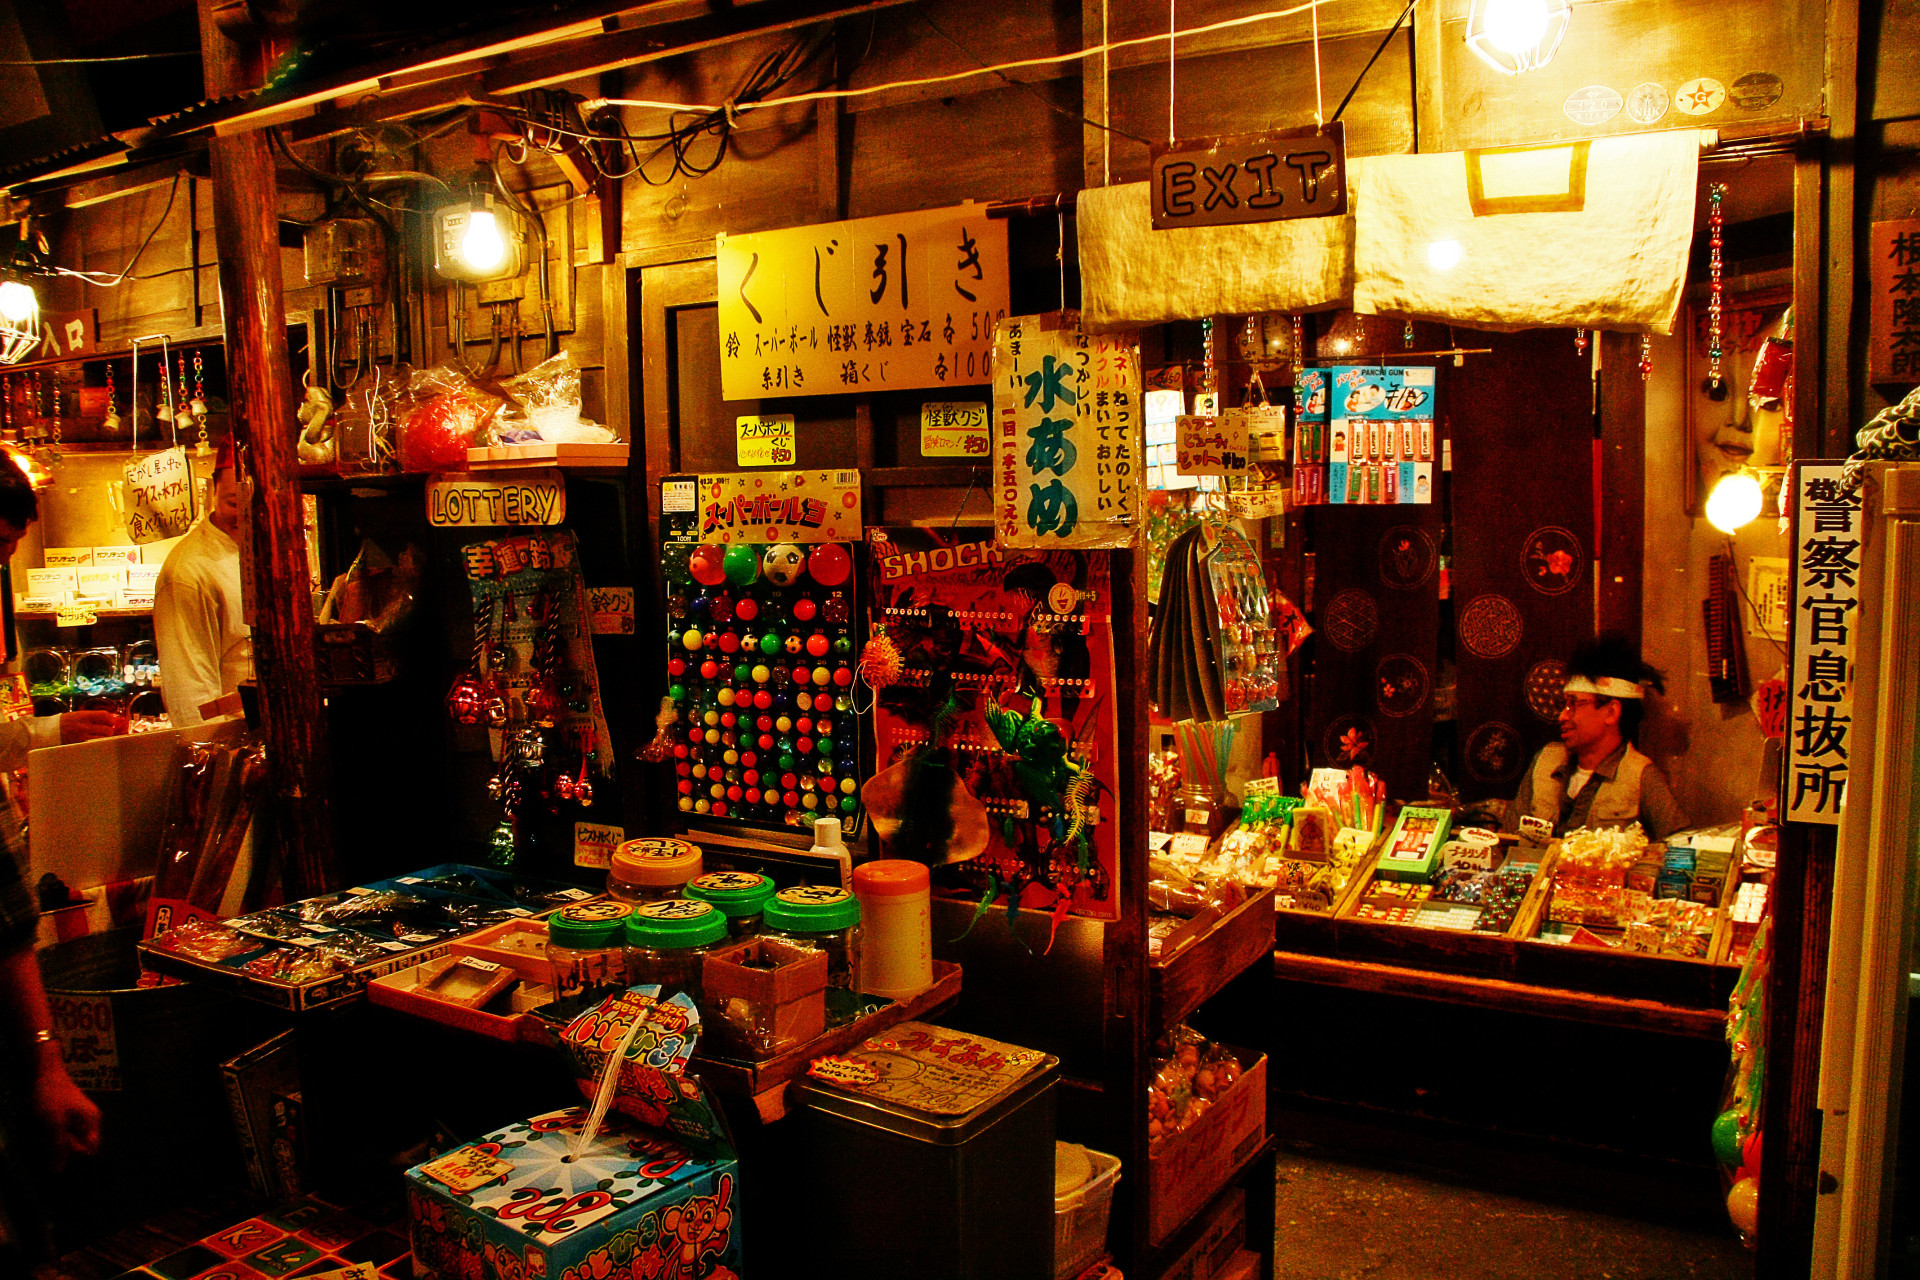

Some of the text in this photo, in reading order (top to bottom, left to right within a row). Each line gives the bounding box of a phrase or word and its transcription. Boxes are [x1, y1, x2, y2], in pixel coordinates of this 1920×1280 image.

[1694, 91, 1708, 104] G
[1162, 150, 1332, 217] EXIT
[740, 226, 983, 325] くじ引き
[41, 317, 84, 358] 入口
[726, 331, 741, 358] 鈴
[754, 325, 818, 357] スーパーボール
[827, 324, 858, 352] 怪獣
[900, 318, 931, 346] 宝石
[1008, 323, 1023, 390] あまーい
[761, 365, 805, 391] 糸引き
[924, 408, 985, 427] 怪獣クジ
[771, 437, 791, 447] くじ
[771, 446, 791, 463] ¥50
[964, 434, 988, 454] ¥50
[1023, 354, 1078, 539] 水あめ
[1178, 449, 1221, 470] セット
[432, 484, 557, 525] LOTTERY
[703, 494, 829, 535] スーパーボール当
[883, 537, 1003, 580] SHOCK
[1790, 478, 1862, 815] 警察官息抜所
